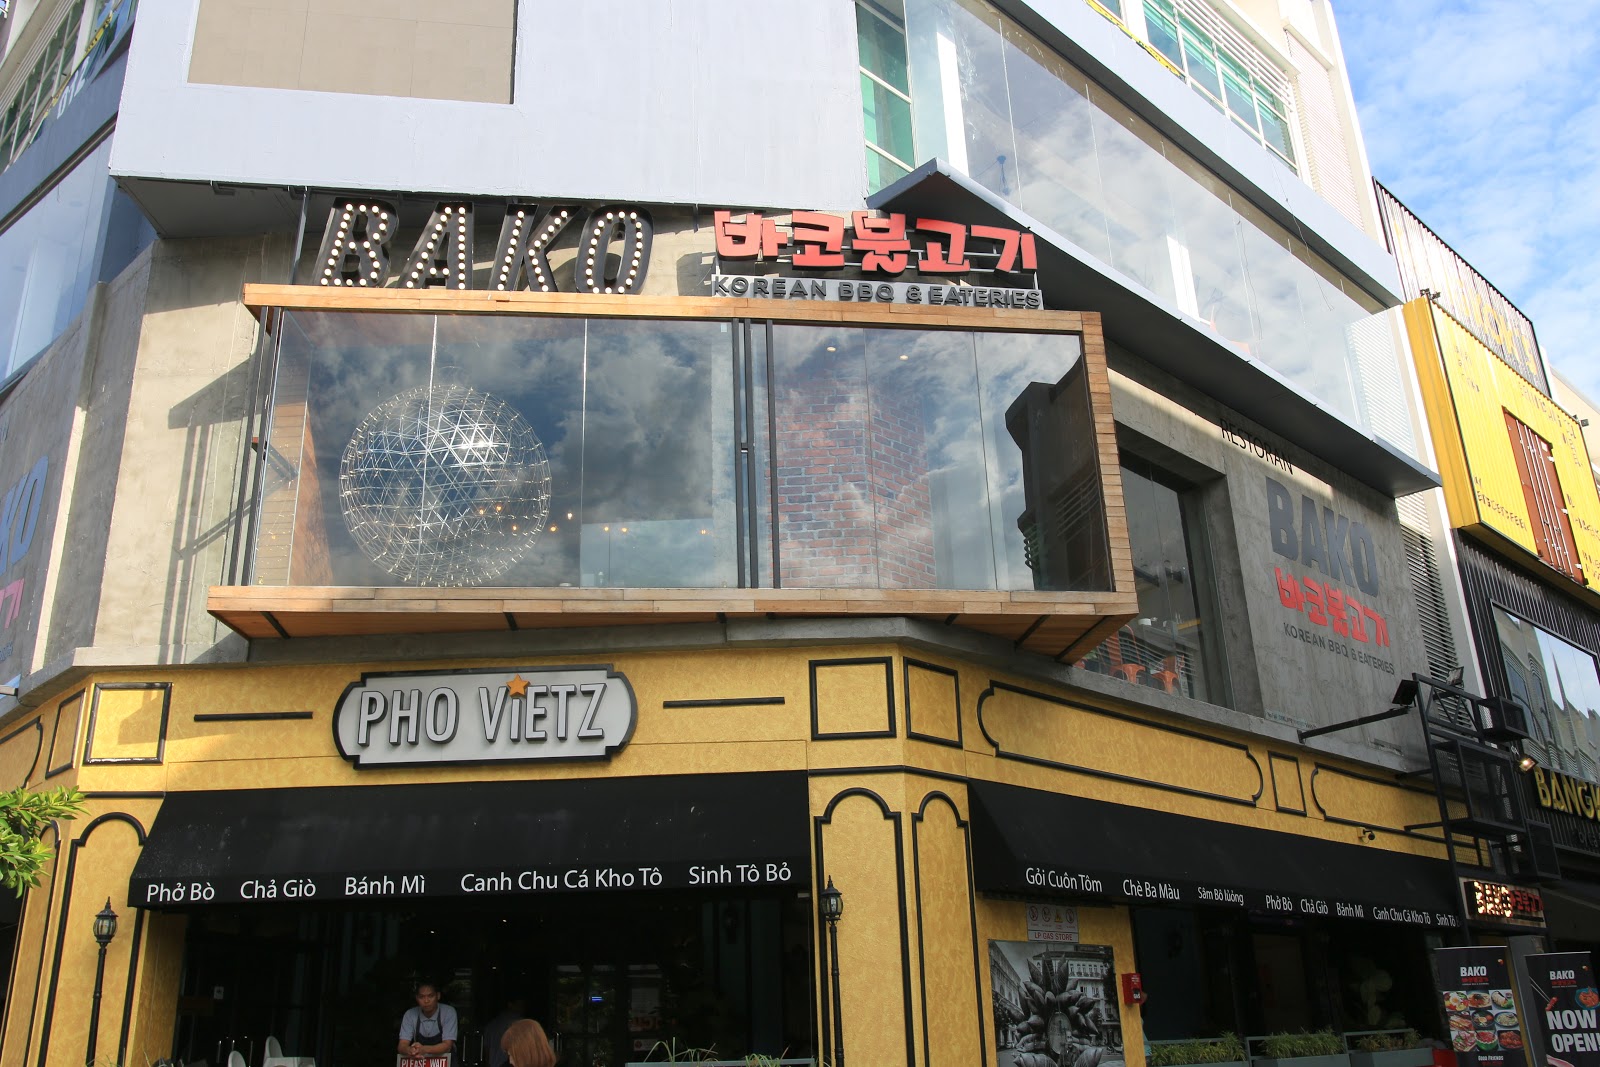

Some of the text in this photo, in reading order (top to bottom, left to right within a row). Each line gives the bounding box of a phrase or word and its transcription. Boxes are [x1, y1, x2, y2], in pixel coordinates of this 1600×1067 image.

[312, 196, 653, 294] BAKO
[714, 275, 1043, 309] KOREAN BBQ & EATERIES
[1220, 418, 1294, 475] RESTORAN
[1265, 475, 1379, 598] BAKO
[1283, 622, 1326, 650] KOREAN
[1327, 639, 1349, 658] BBQ
[1358, 651, 1395, 676] EATERIES
[357, 686, 460, 747] PHO
[460, 866, 663, 893] Canh Chu Cá Kho Tô
[688, 861, 792, 885] Sinh Tô Bỏ
[1026, 867, 1103, 892] Gỏi Cuôn Tôm
[147, 882, 216, 902] Phở Bò
[240, 878, 317, 899] Chả Giò
[345, 874, 425, 896] Bánh Mì
[1122, 879, 1180, 900] Chè Ba Màu
[1281, 896, 1293, 911] Bò
[1372, 906, 1390, 920] Canh
[1034, 931, 1073, 941] LP GAS STORE
[1460, 965, 1487, 977] BAKO
[1549, 970, 1575, 981] BAKO
[1546, 1009, 1597, 1030] NOW
